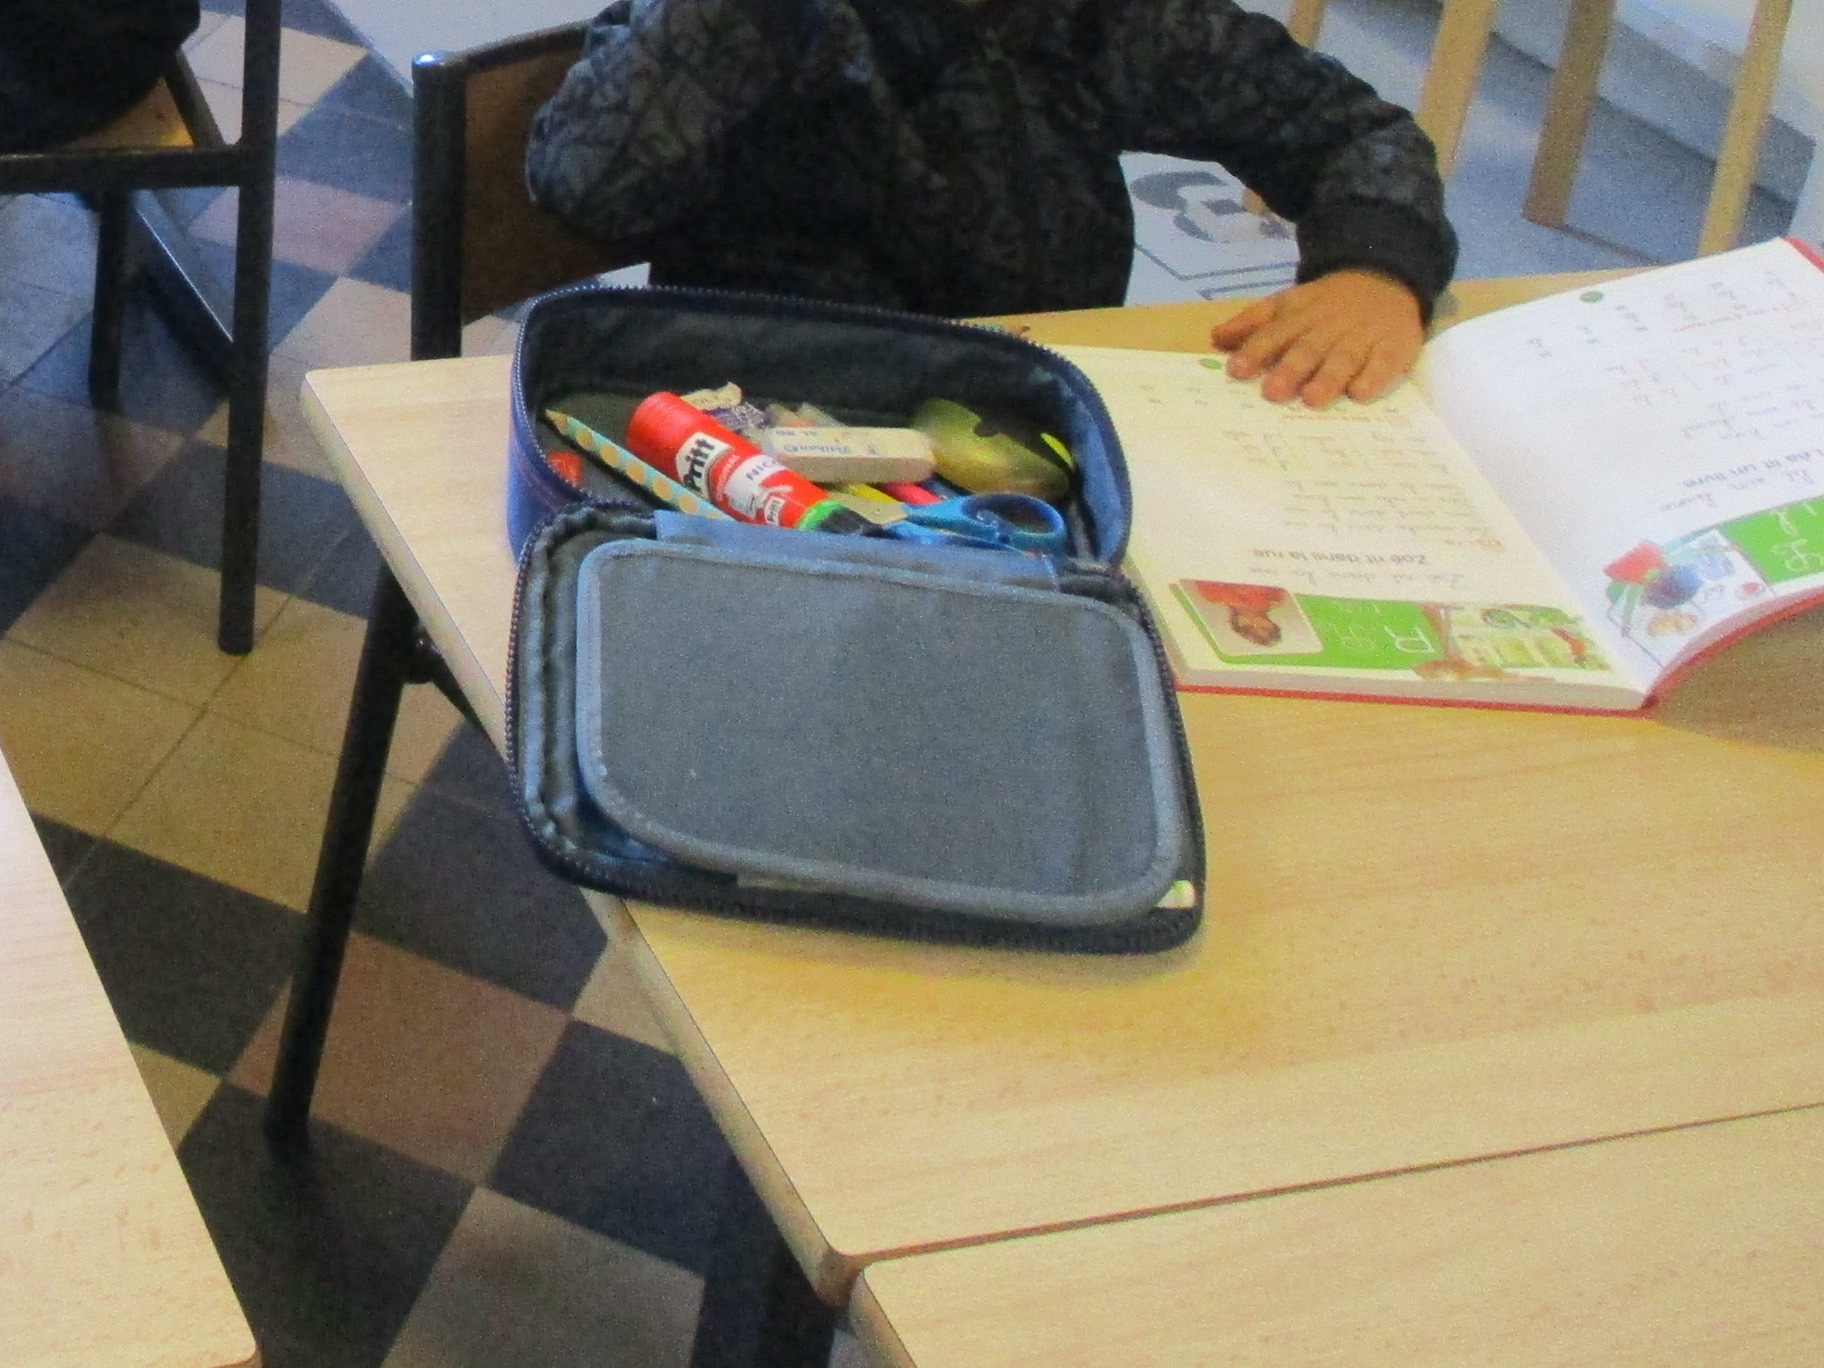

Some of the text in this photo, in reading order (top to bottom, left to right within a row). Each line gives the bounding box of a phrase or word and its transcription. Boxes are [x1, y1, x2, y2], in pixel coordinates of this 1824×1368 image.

[683, 437, 716, 496] Pritt
[1252, 548, 1285, 560] rue
[1287, 550, 1309, 563] la
[1311, 551, 1362, 565] dans
[1389, 554, 1428, 567] Zoé
[1383, 625, 1437, 654] R
